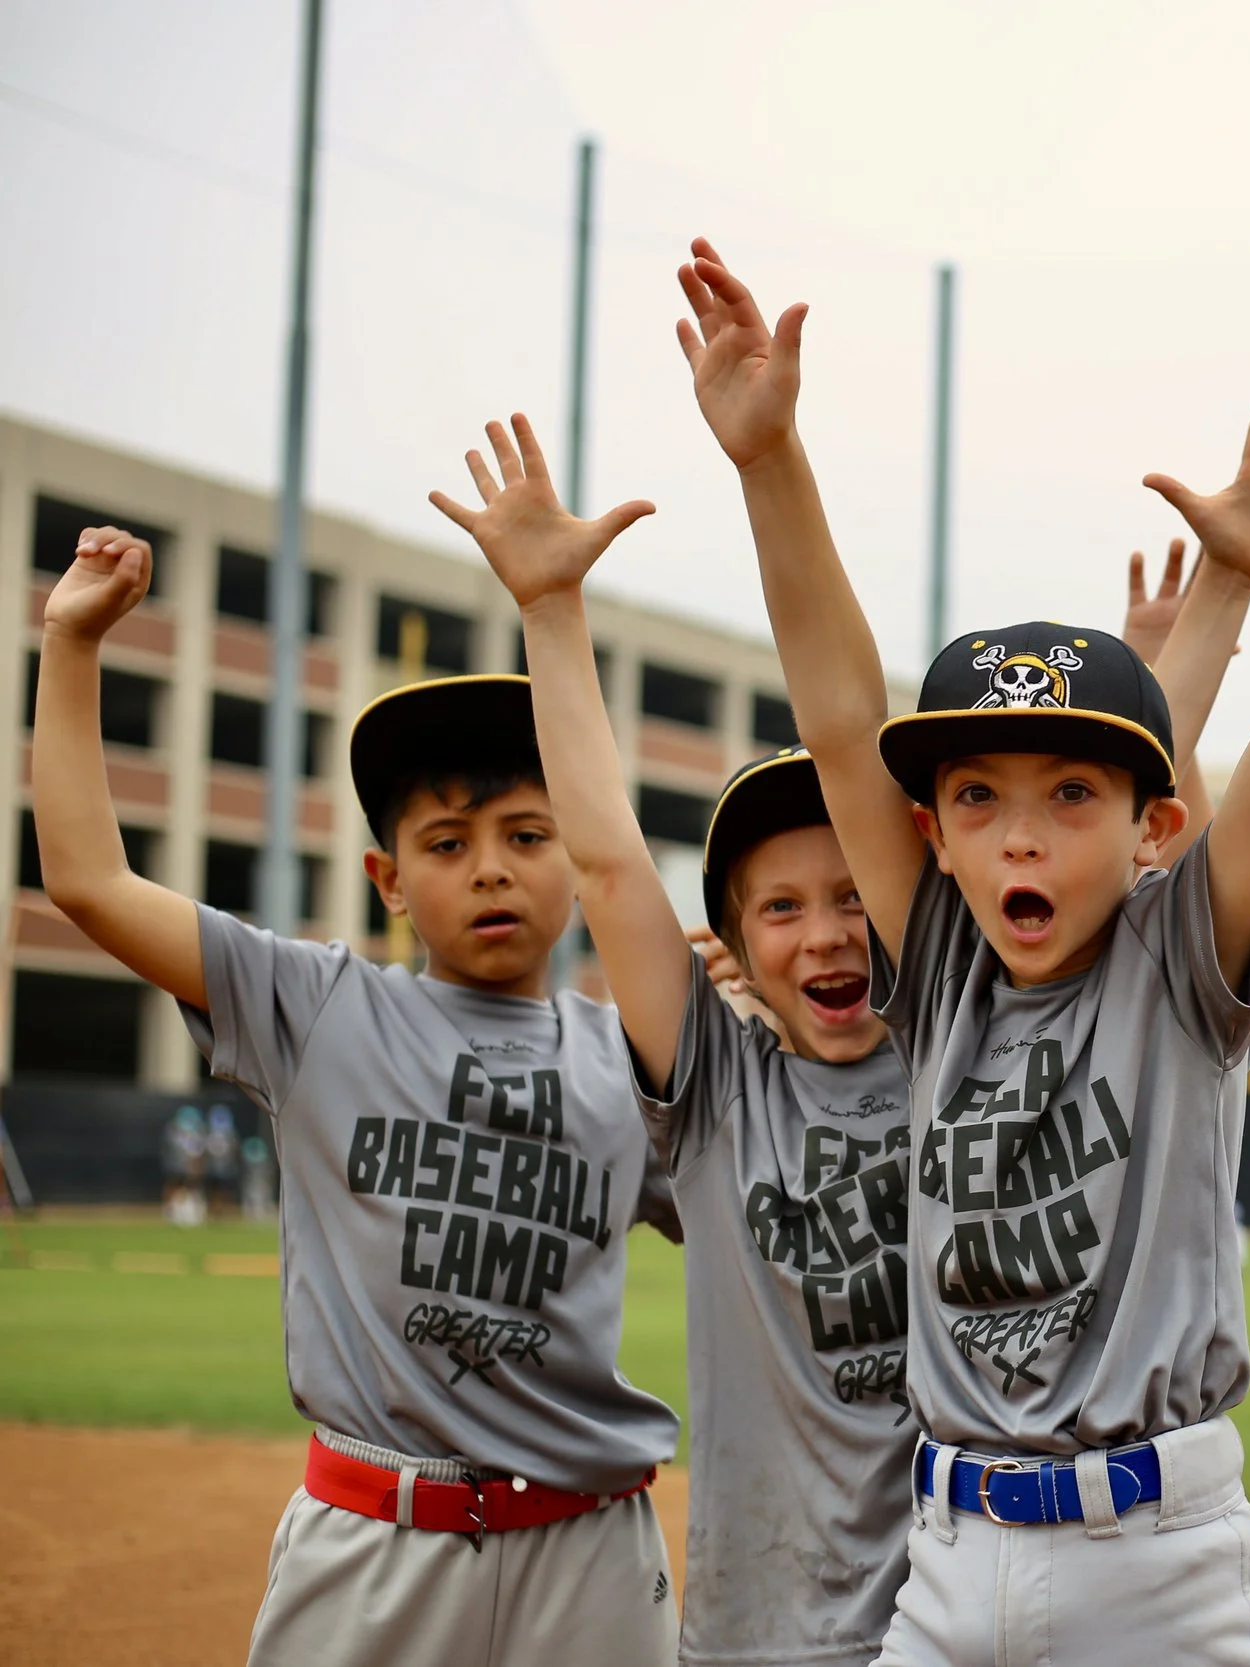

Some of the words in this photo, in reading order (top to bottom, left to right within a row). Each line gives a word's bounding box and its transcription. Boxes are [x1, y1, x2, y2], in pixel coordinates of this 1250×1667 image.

[448, 1053, 564, 1141] FCA
[400, 1206, 568, 1311] CAMP
[403, 1303, 551, 1367] GREATER
[950, 1285, 1098, 1357] GREATER
